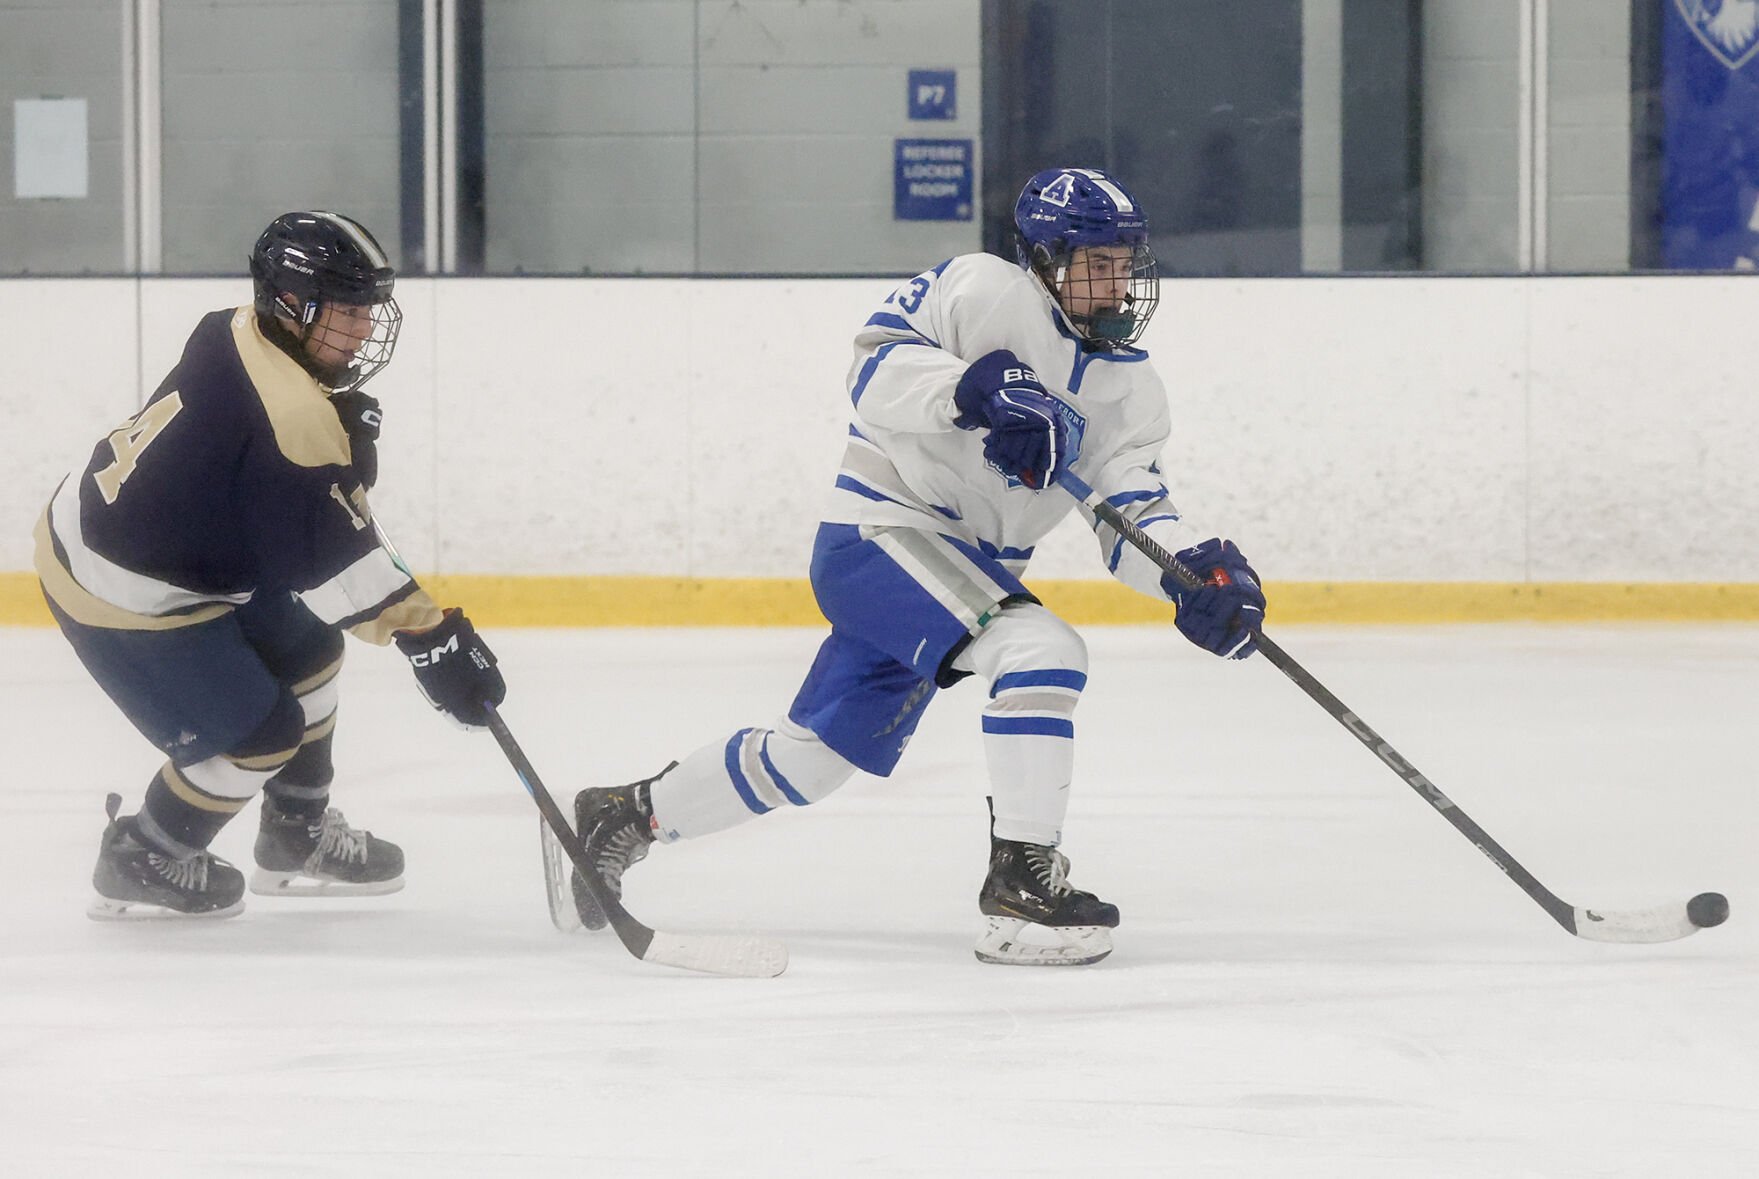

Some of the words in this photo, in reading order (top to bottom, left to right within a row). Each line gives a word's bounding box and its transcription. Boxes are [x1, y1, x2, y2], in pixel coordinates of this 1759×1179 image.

[917, 84, 945, 105] P7
[903, 146, 965, 160] REFEREE
[903, 164, 964, 179] LOCKER
[910, 182, 958, 197] ROOM
[1040, 173, 1075, 208] A
[282, 259, 315, 276] BAUER
[93, 390, 184, 505] 4
[1341, 711, 1455, 811] CCM
